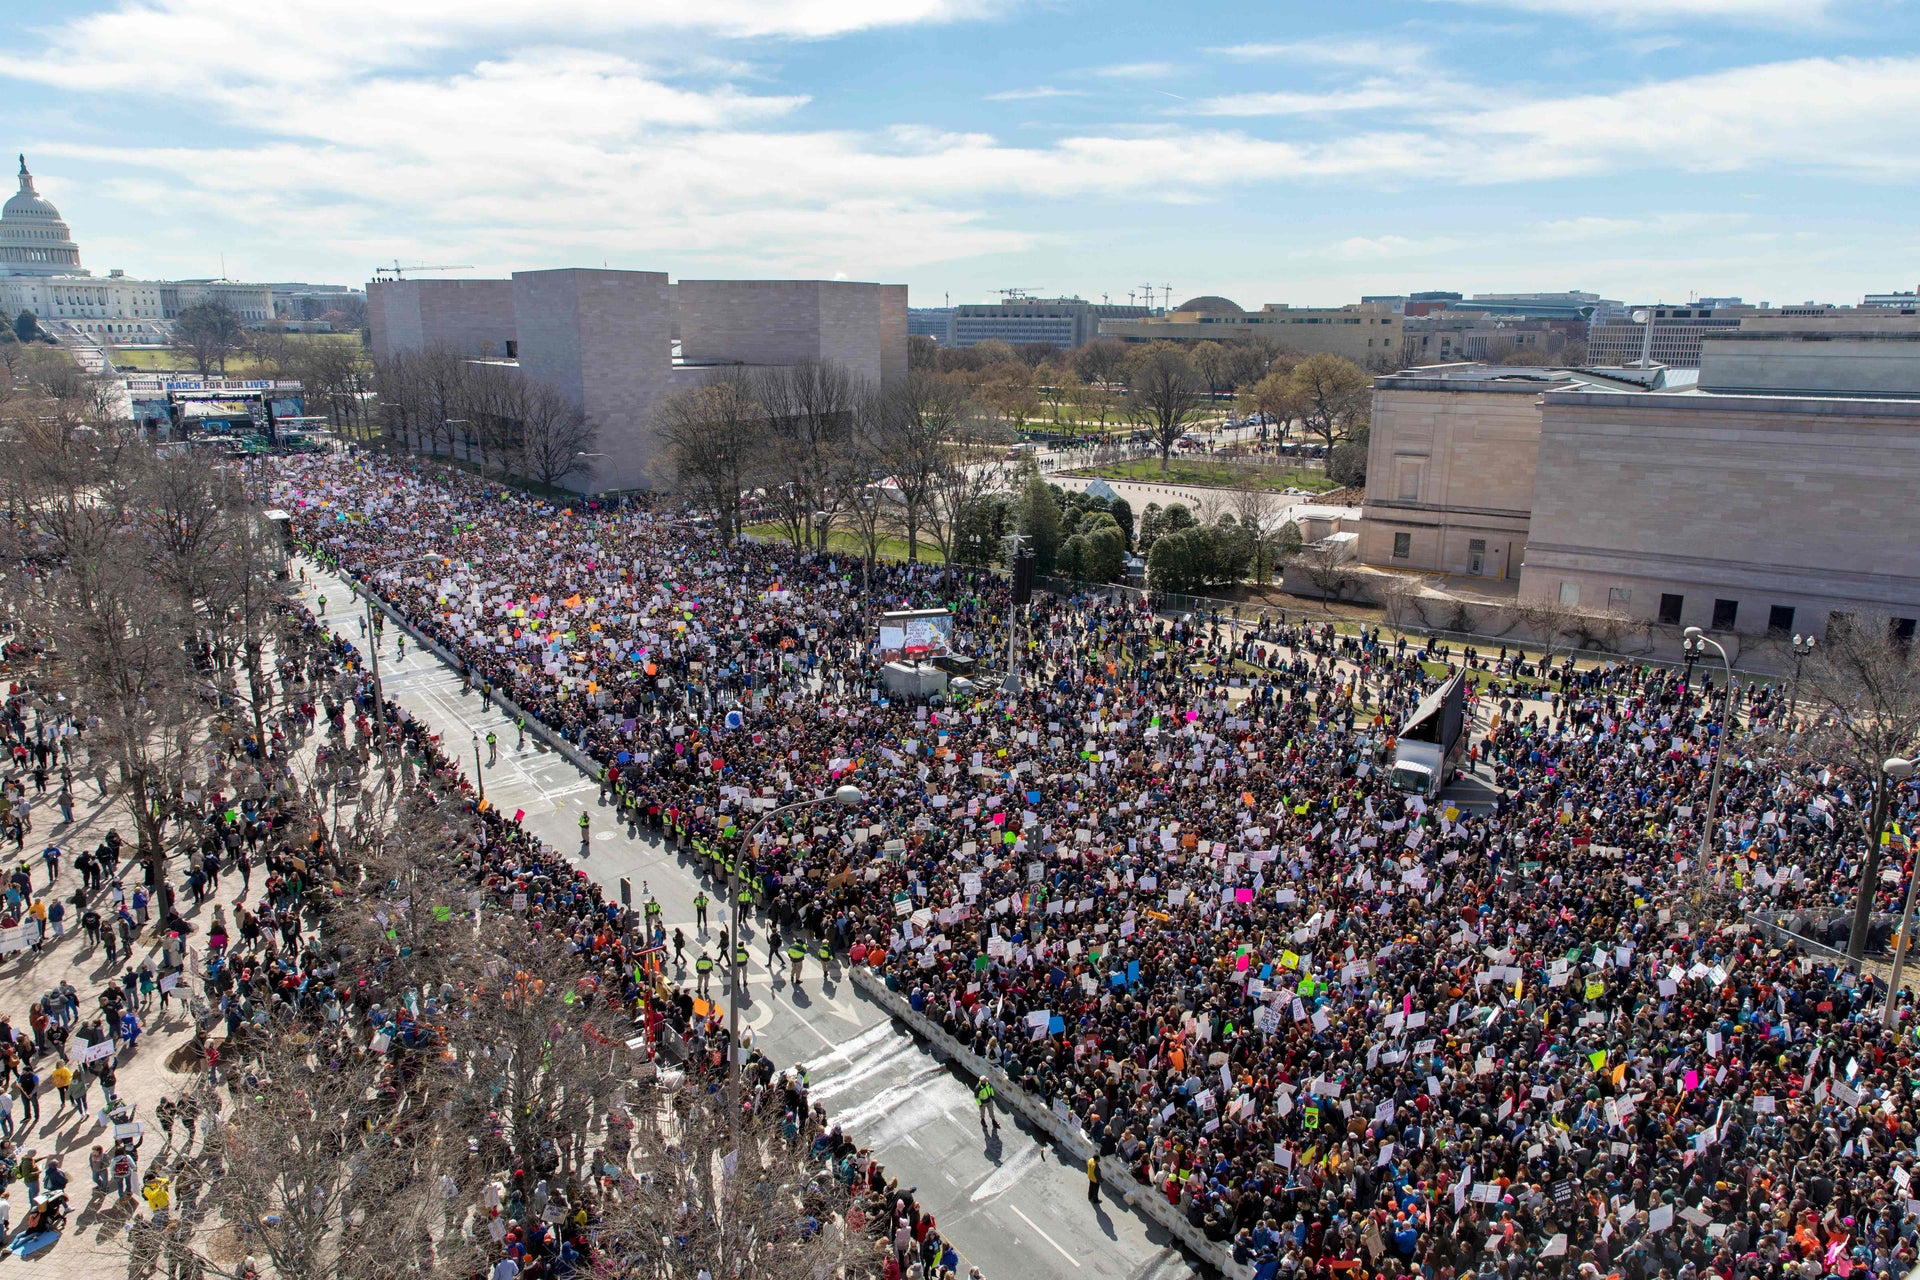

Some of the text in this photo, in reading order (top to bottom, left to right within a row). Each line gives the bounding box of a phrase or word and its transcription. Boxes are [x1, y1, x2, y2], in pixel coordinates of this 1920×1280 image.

[166, 380, 270, 390] MARCH FOR OUR LIVES
